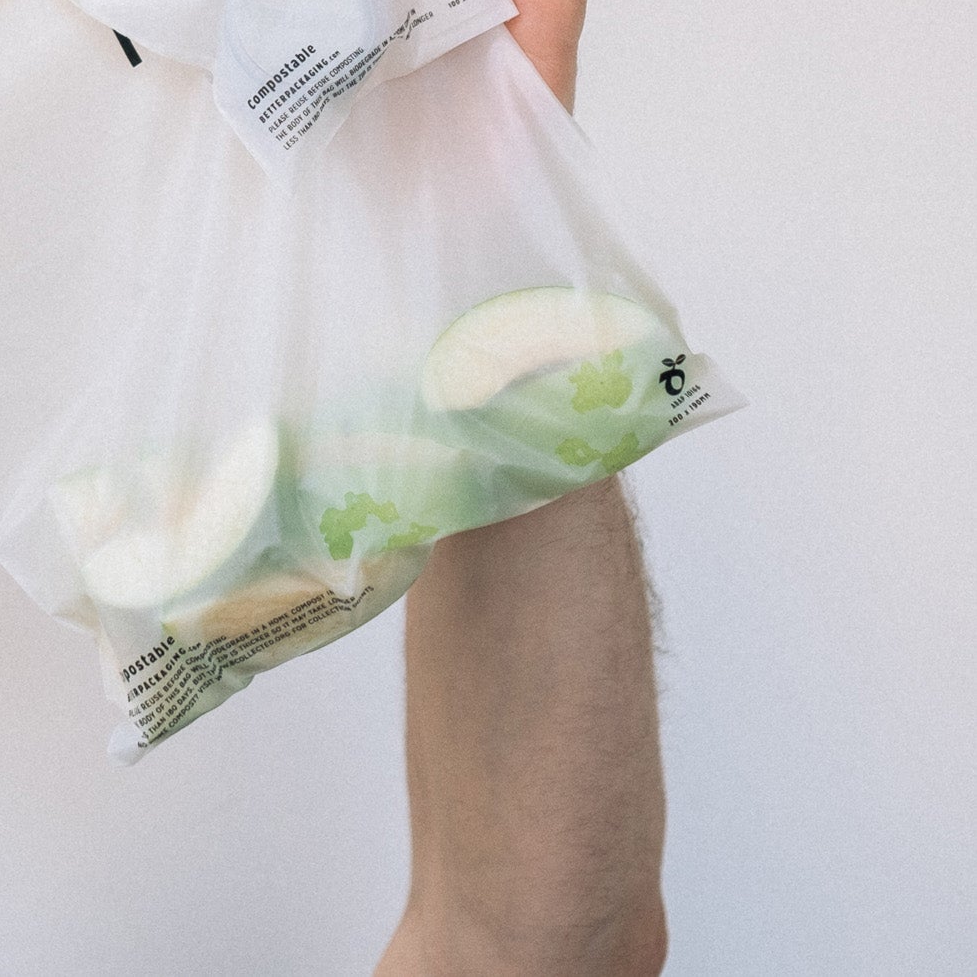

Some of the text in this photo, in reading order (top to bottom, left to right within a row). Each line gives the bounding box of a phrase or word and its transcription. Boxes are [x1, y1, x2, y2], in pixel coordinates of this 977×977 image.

[448, 0, 461, 9] 100
[247, 44, 316, 110] Compostable
[268, 112, 289, 133] PLEASE
[288, 94, 308, 114] REUSE
[307, 75, 330, 97] BEFORE
[329, 47, 364, 78] COMPOSTING
[275, 131, 288, 141] THE
[287, 114, 303, 131] BODY
[303, 106, 311, 117] OF
[311, 94, 323, 109] THIS
[322, 84, 335, 96] BAG
[335, 74, 349, 87] WILL
[349, 45, 381, 76] BIODEGRADE
[282, 134, 299, 151] LESS
[297, 120, 313, 137] THAN
[332, 87, 345, 98] BUT
[345, 78, 358, 90] THE
[668, 413, 684, 426] 200
[689, 392, 711, 411] 190MM
[138, 712, 156, 726] BODY
[155, 703, 165, 714] OF
[164, 688, 180, 704] THIS
[179, 672, 192, 688] BAG
[190, 663, 209, 673] WILL
[268, 613, 290, 627] HOME
[290, 593, 325, 615] COMPOST
[140, 635, 227, 710] REUSE BEFORE COMPOSTING
[148, 716, 167, 734] THAN
[165, 704, 178, 718] 180
[192, 672, 207, 686] BUT
[216, 653, 229, 662] ZIP
[238, 631, 270, 651] THICKER
[271, 626, 282, 634] SO
[282, 621, 290, 629] IT
[291, 613, 306, 624] MAY
[308, 603, 327, 615] TAKE
[168, 693, 200, 728] COMPOST?
[198, 678, 215, 693] VISIT
[292, 623, 307, 635] FOR
